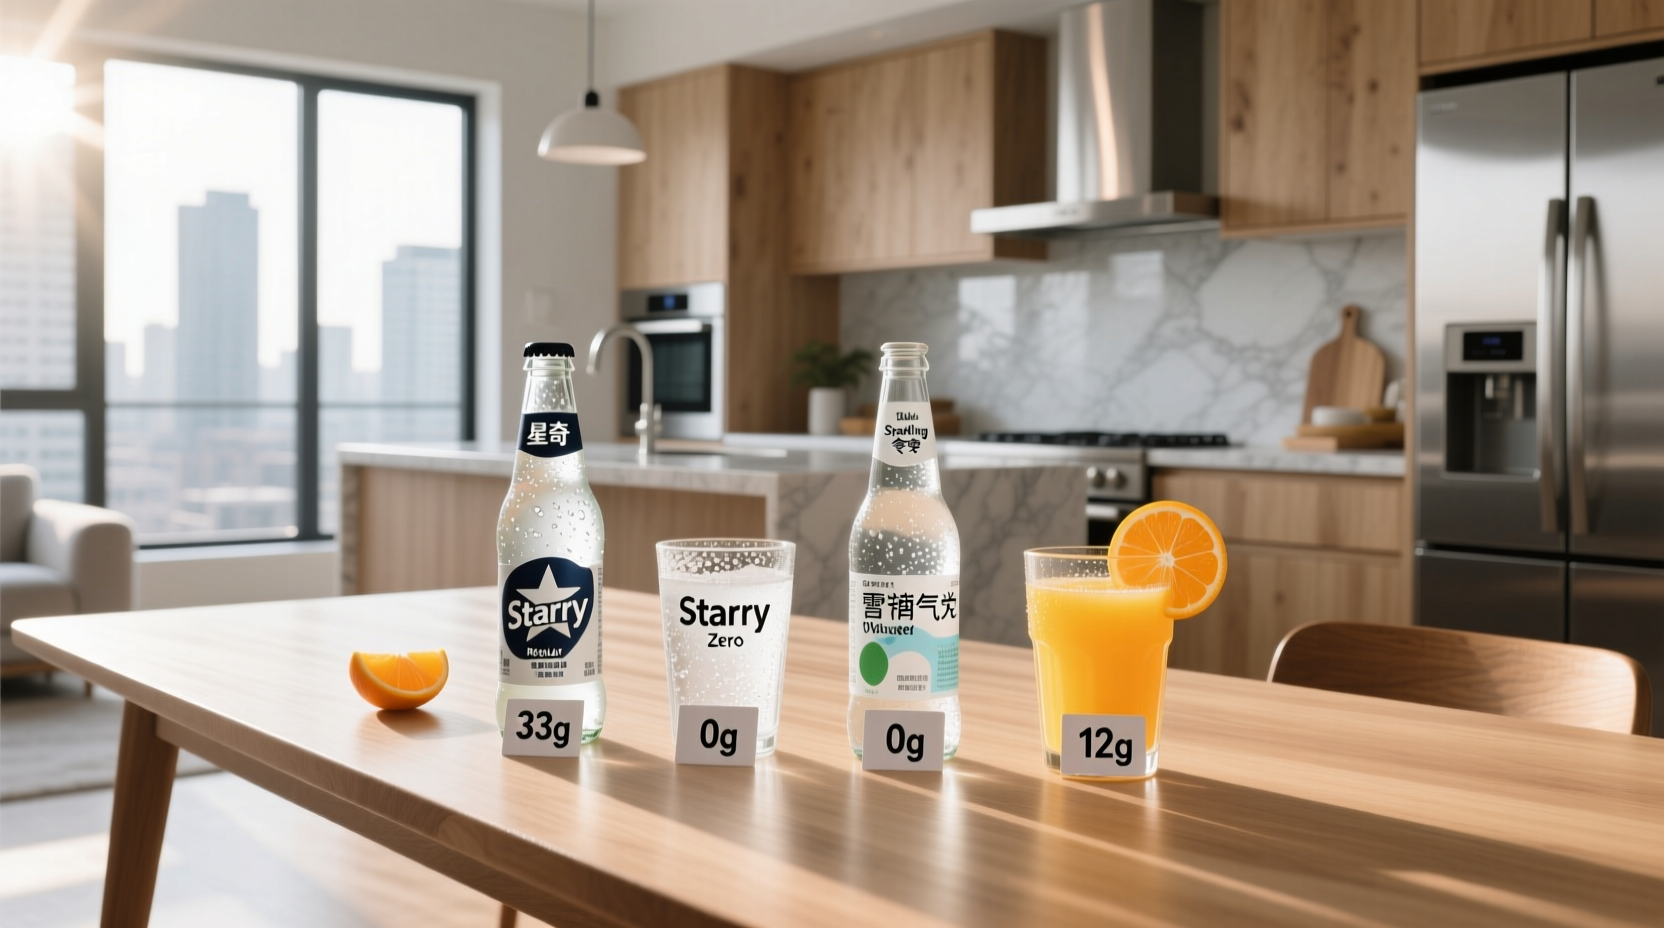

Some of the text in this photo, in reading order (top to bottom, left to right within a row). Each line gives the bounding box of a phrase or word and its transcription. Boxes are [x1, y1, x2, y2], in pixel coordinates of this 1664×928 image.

[527, 421, 570, 447] 星奇
[507, 597, 589, 630] Starry
[679, 595, 771, 634] Starry
[707, 632, 744, 648] Zero
[515, 710, 571, 749] 33g
[700, 718, 738, 757] 0g
[886, 723, 925, 763] 0g
[1079, 726, 1133, 767] 12g
